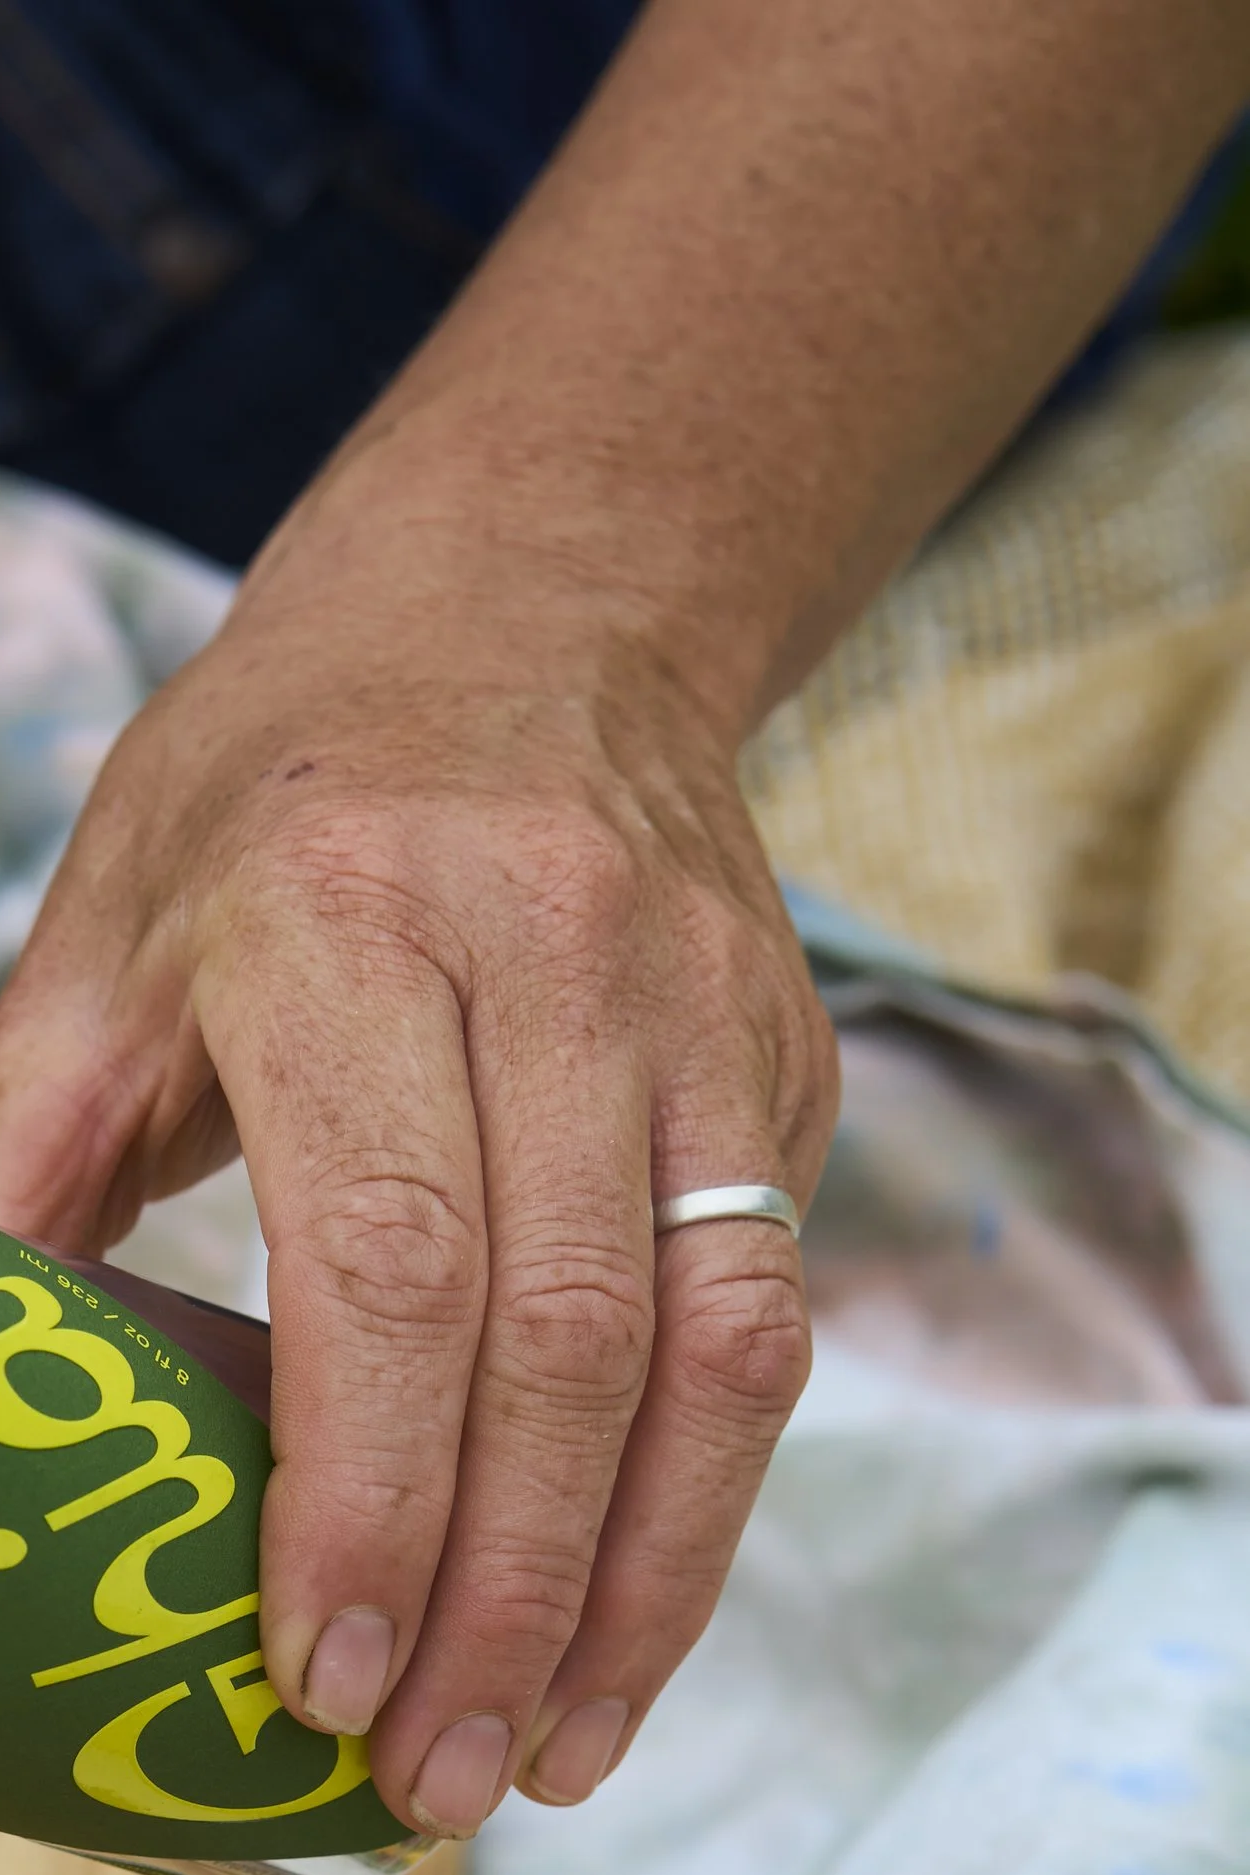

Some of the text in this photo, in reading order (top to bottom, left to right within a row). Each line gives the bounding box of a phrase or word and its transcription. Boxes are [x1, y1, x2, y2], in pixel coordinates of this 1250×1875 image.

[19, 1250, 49, 1273] ml
[57, 1274, 99, 1309] 236
[124, 1323, 150, 1348] oz
[154, 1349, 171, 1369] fl
[176, 1369, 190, 1385] 8
